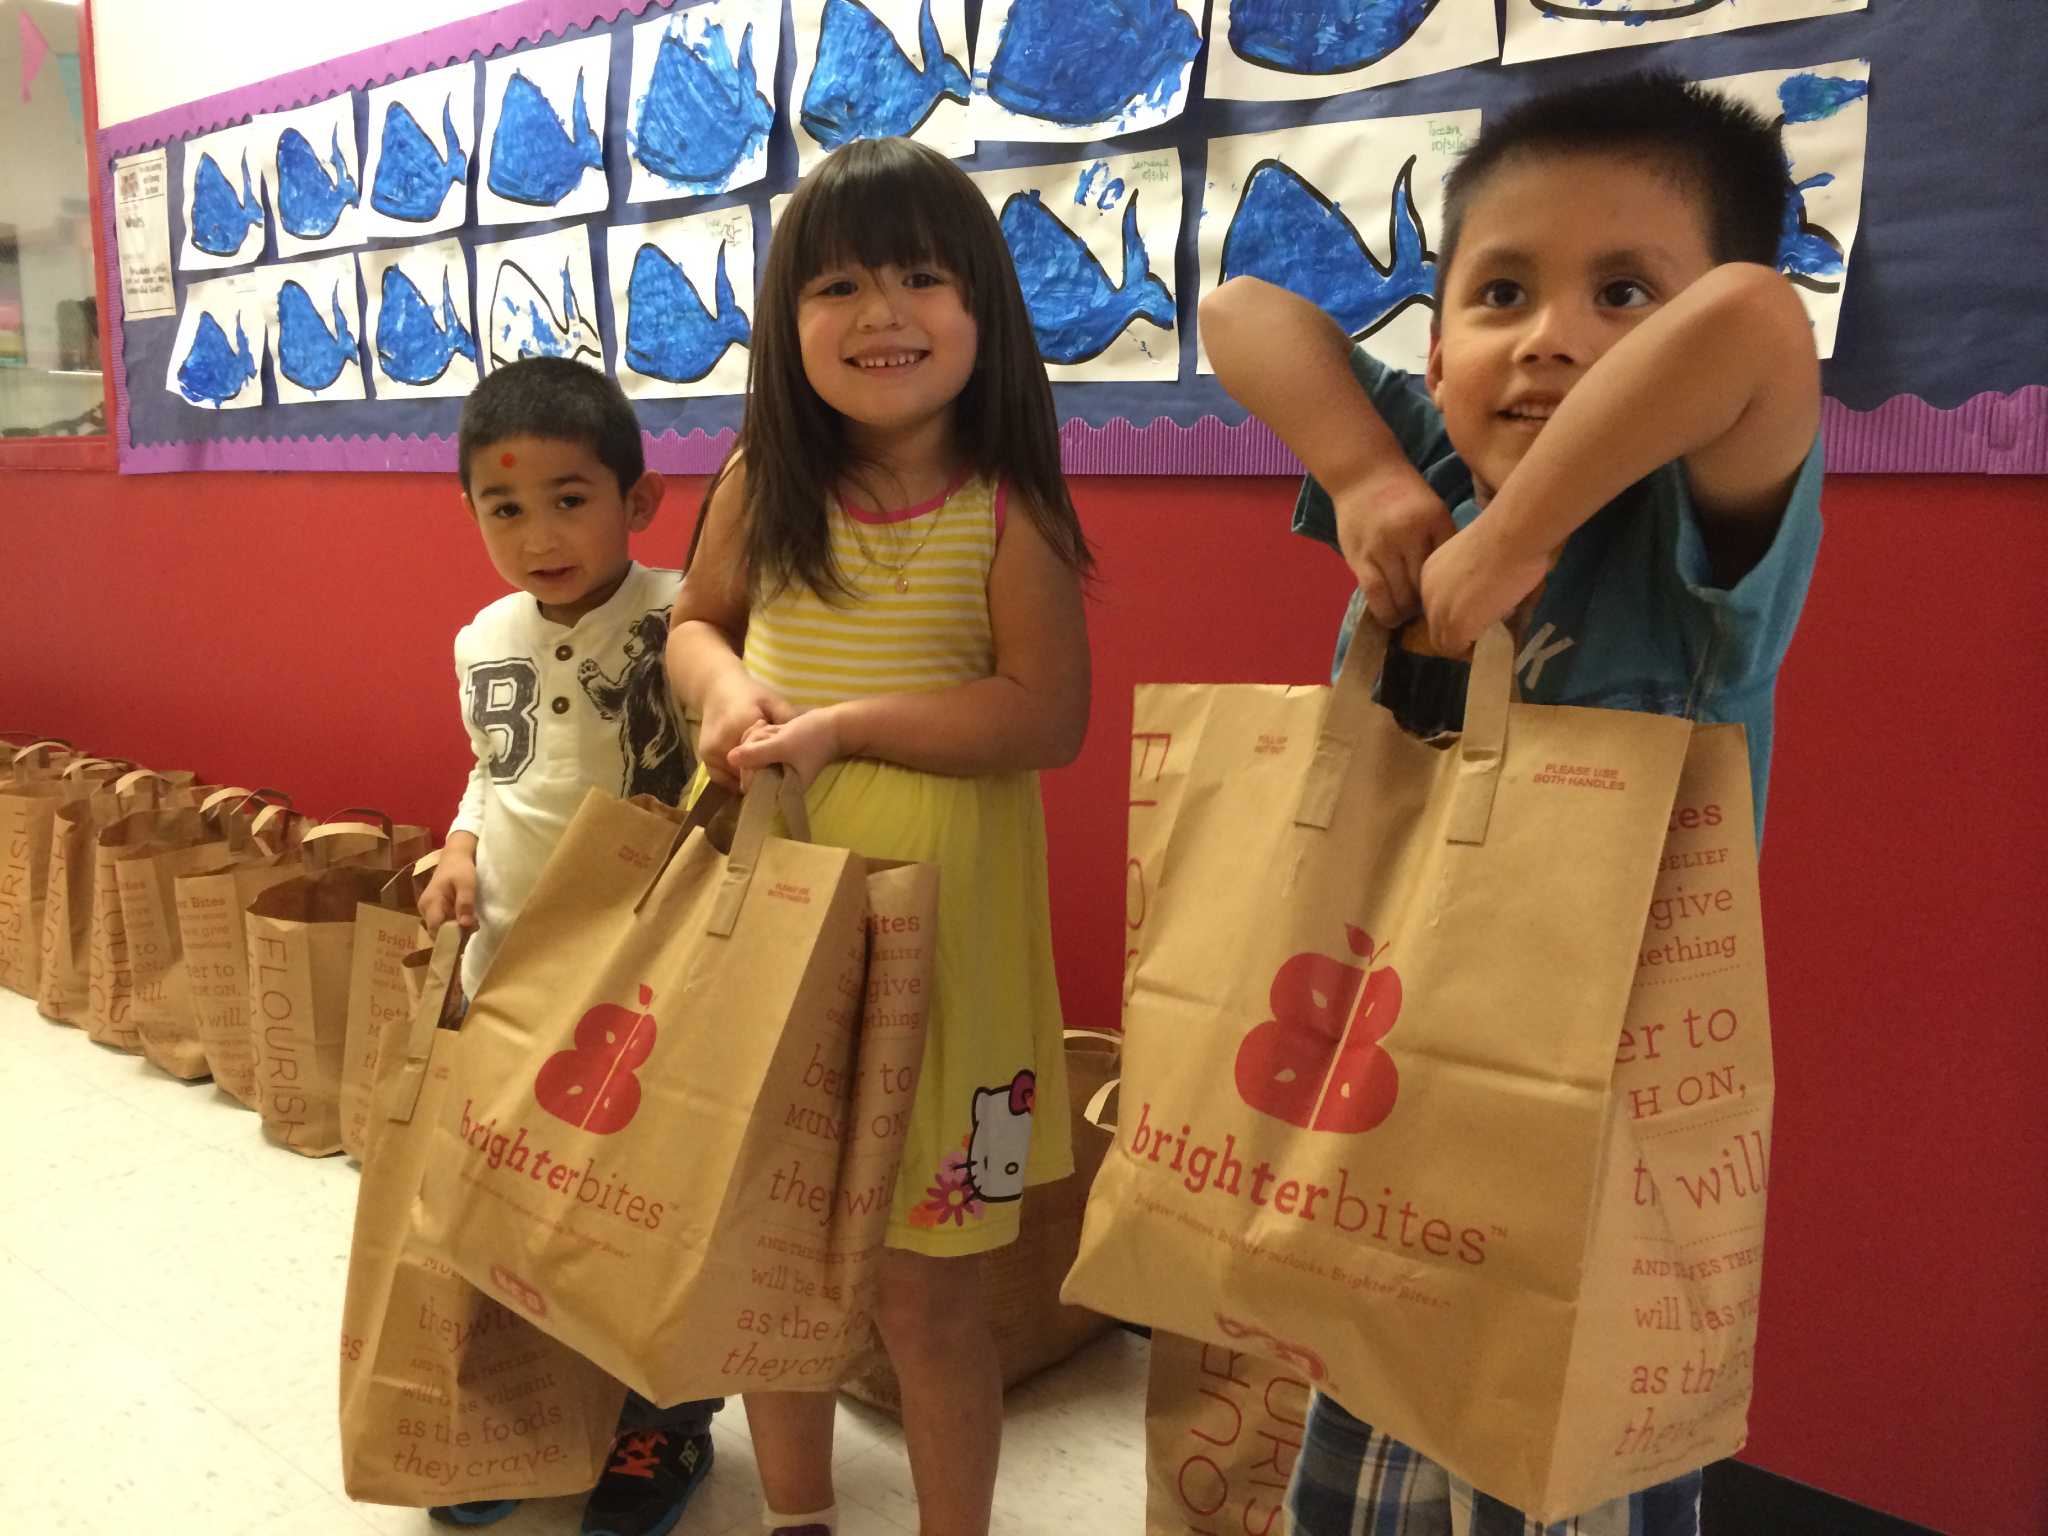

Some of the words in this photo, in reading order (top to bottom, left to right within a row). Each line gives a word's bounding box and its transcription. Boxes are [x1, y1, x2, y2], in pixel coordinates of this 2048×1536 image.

[467, 657, 541, 786] B
[1533, 773, 1566, 785] BOTH
[1568, 777, 1625, 791] HANDLES
[1545, 763, 1590, 776] PLEASE
[1650, 886, 1733, 930] give
[214, 962, 235, 977] to
[1683, 1008, 1737, 1048] to
[880, 1063, 912, 1094] to
[1678, 1065, 1746, 1106] ON,
[459, 1099, 663, 1230] brighterbites
[1131, 1103, 1486, 1265] brighterbites
[752, 1264, 788, 1291] will
[737, 1308, 772, 1335] as
[781, 1305, 829, 1341] the
[1634, 1297, 1681, 1331] will
[721, 1343, 795, 1382] they
[1630, 1365, 1669, 1394] as
[397, 1417, 426, 1438] as
[482, 1401, 562, 1444] foods
[392, 1443, 460, 1486] they
[467, 1442, 568, 1478] crave.
